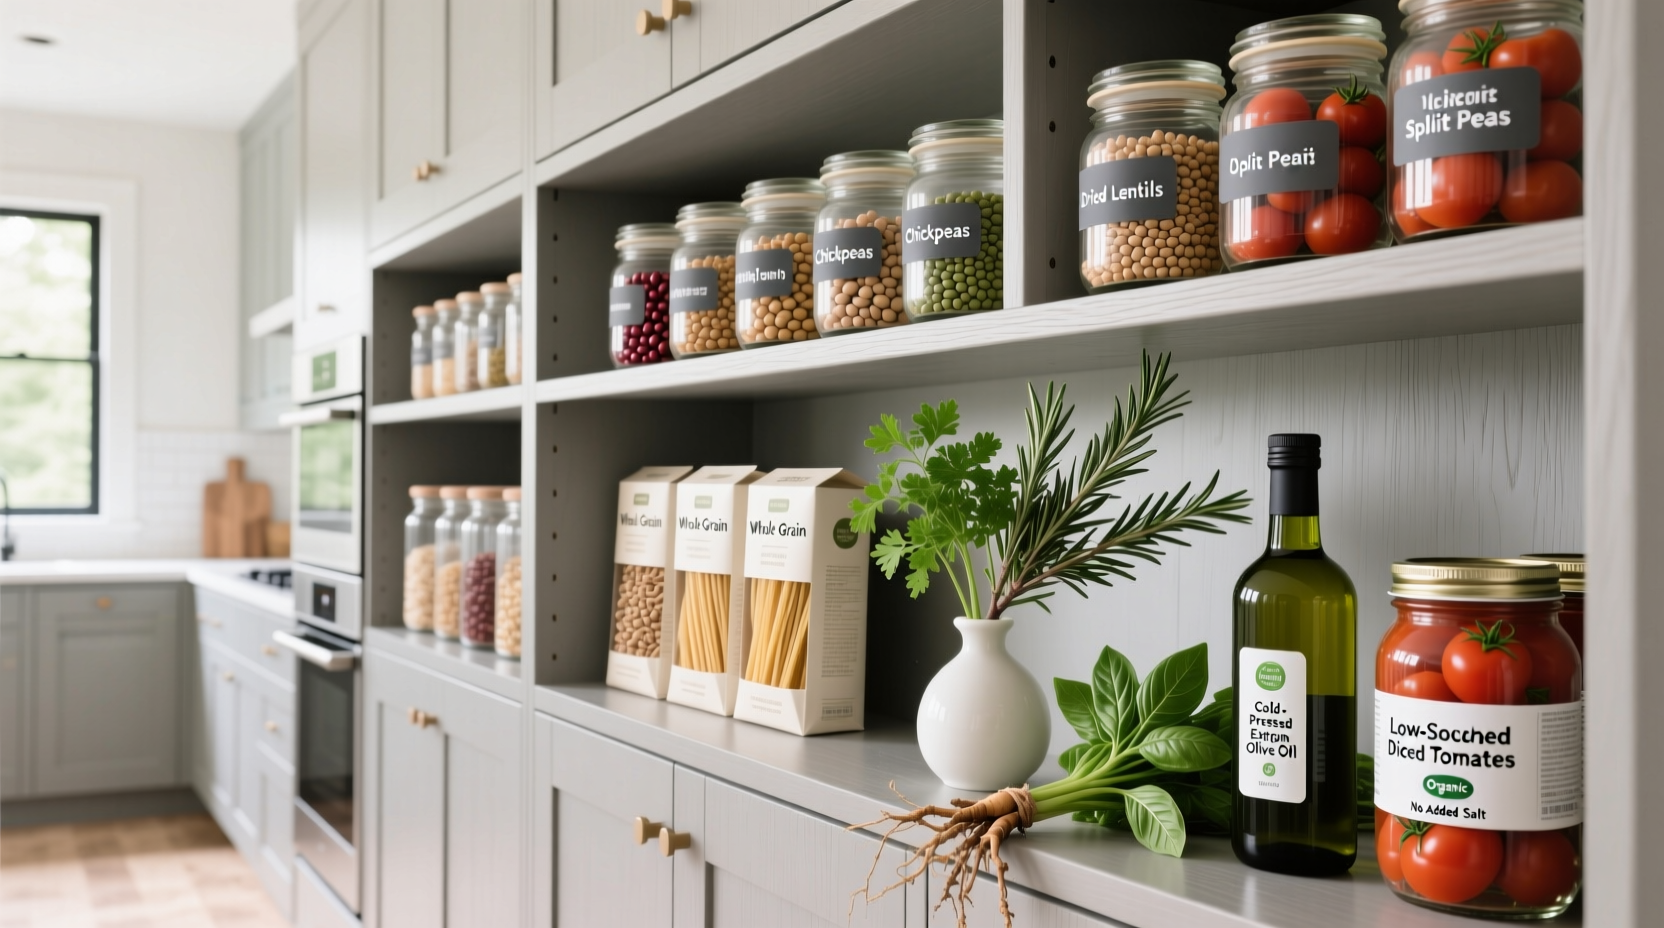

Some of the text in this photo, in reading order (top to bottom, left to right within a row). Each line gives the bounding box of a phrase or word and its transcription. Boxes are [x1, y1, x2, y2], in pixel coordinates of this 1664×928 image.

[1457, 109, 1511, 130] Peas
[1111, 180, 1164, 201] Lentils
[905, 223, 971, 245] Chickpeas
[815, 245, 874, 265] Chickpeas
[701, 517, 728, 532] Grain
[778, 522, 807, 538] Grain
[1246, 741, 1276, 756] Olive
[1388, 738, 1516, 769] Diced Tomates
[1410, 801, 1487, 820] No Added Salt
